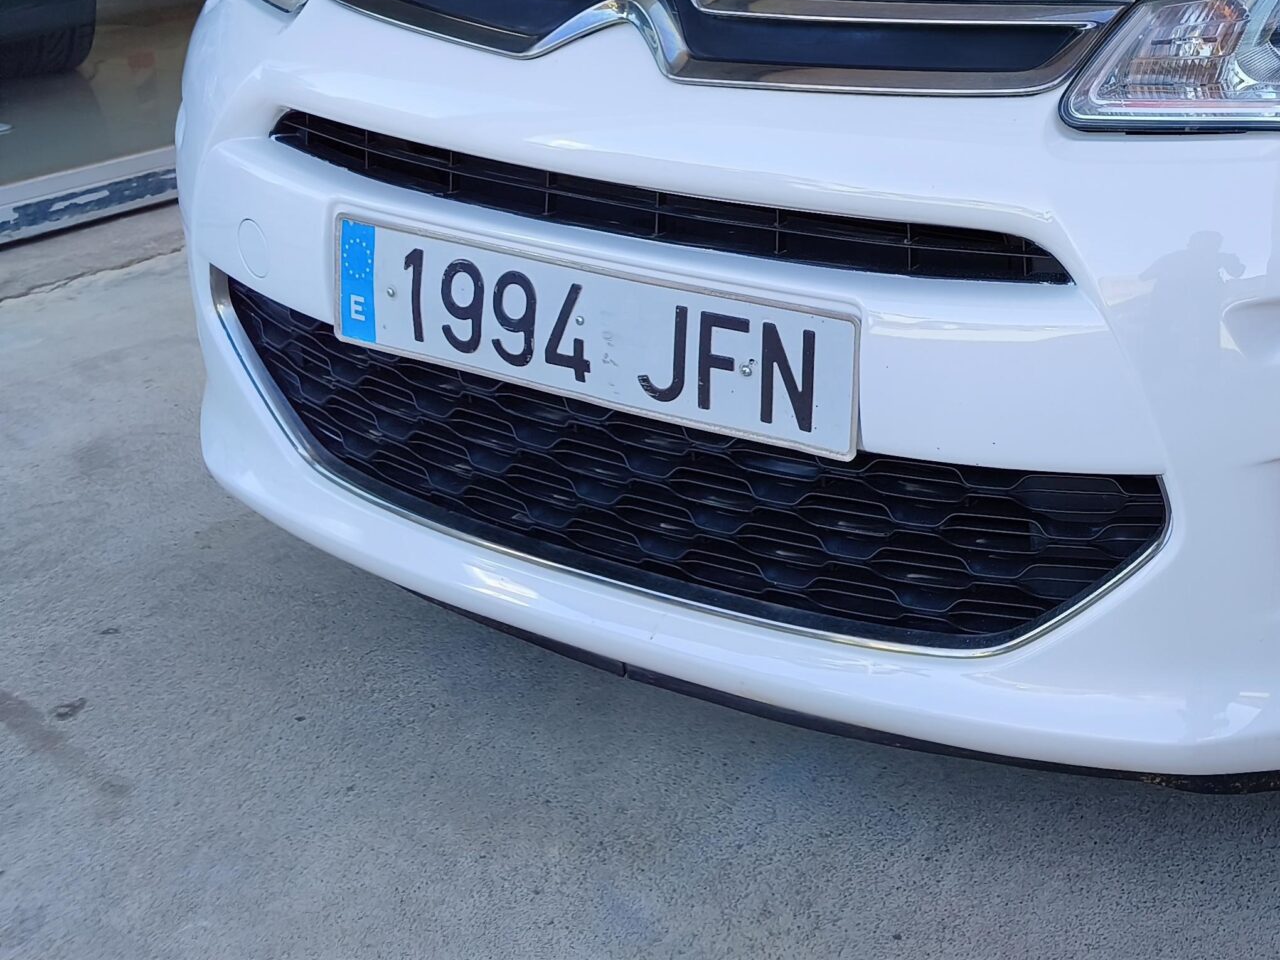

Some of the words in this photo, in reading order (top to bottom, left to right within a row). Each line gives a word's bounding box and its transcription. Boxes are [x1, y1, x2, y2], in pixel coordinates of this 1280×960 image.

[350, 294, 366, 321] E
[403, 248, 591, 383] 1994
[637, 305, 816, 433] JFN
